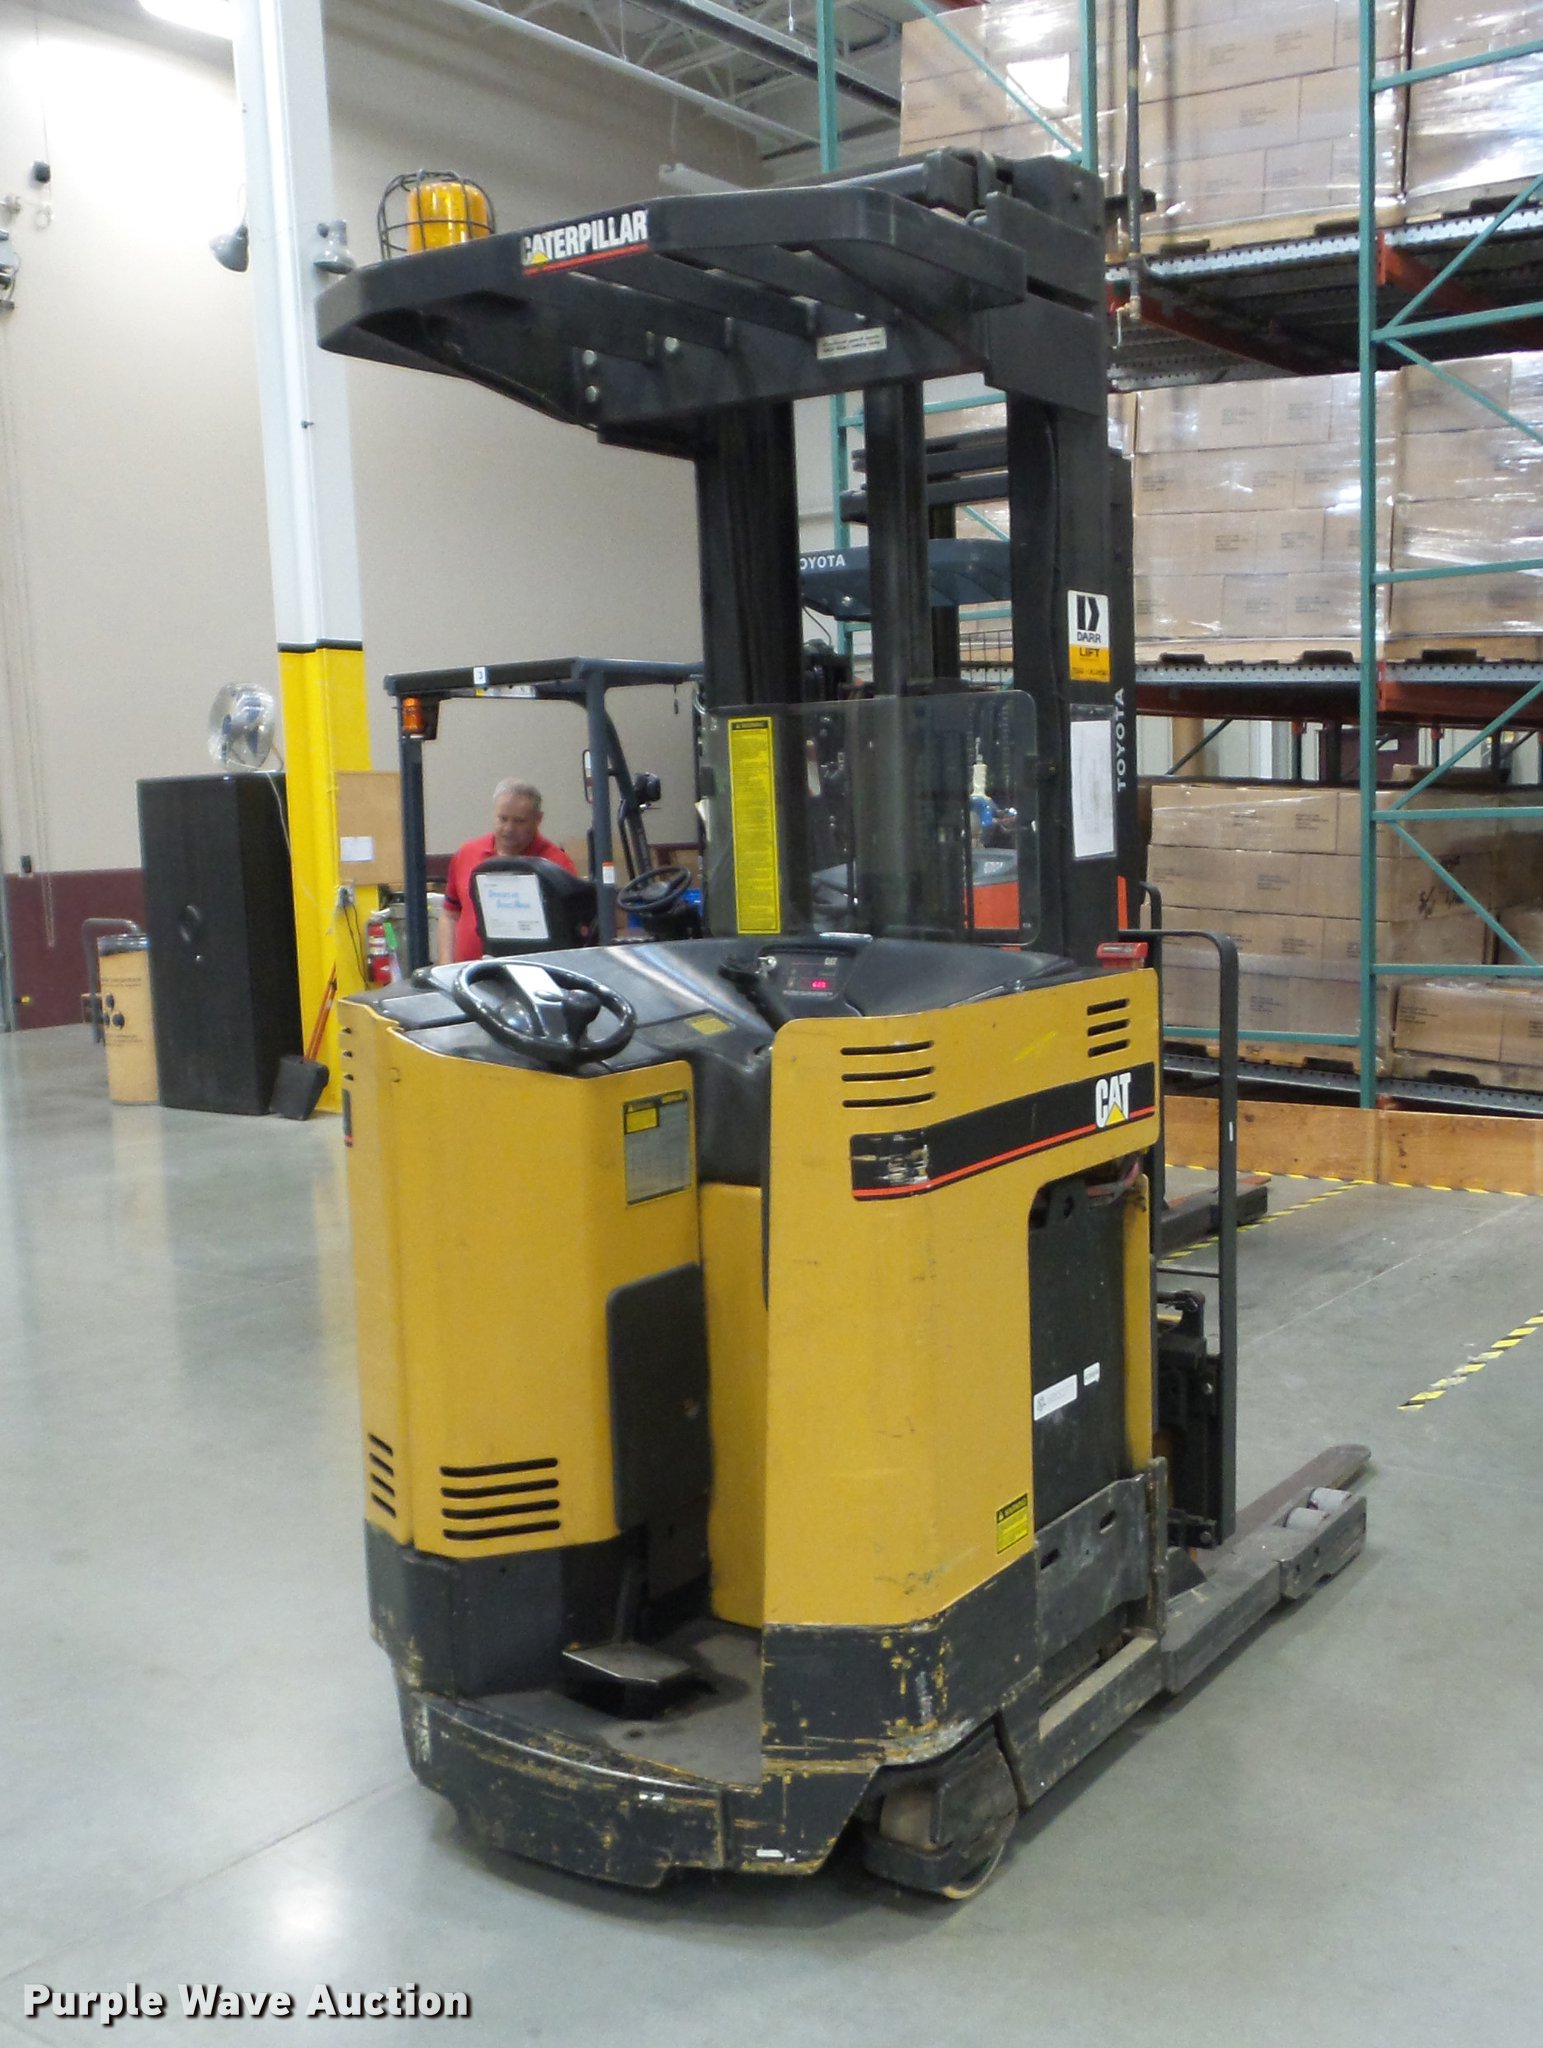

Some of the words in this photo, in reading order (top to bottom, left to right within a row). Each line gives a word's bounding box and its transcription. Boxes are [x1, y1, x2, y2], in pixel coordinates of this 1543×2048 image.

[522, 208, 648, 266] CATERPILLAR
[799, 553, 846, 570] OYOTA
[1077, 631, 1102, 643] DARR
[1080, 648, 1100, 657] LIFT
[1114, 687, 1127, 793] TOYOTA
[1095, 1072, 1131, 1128] CAT
